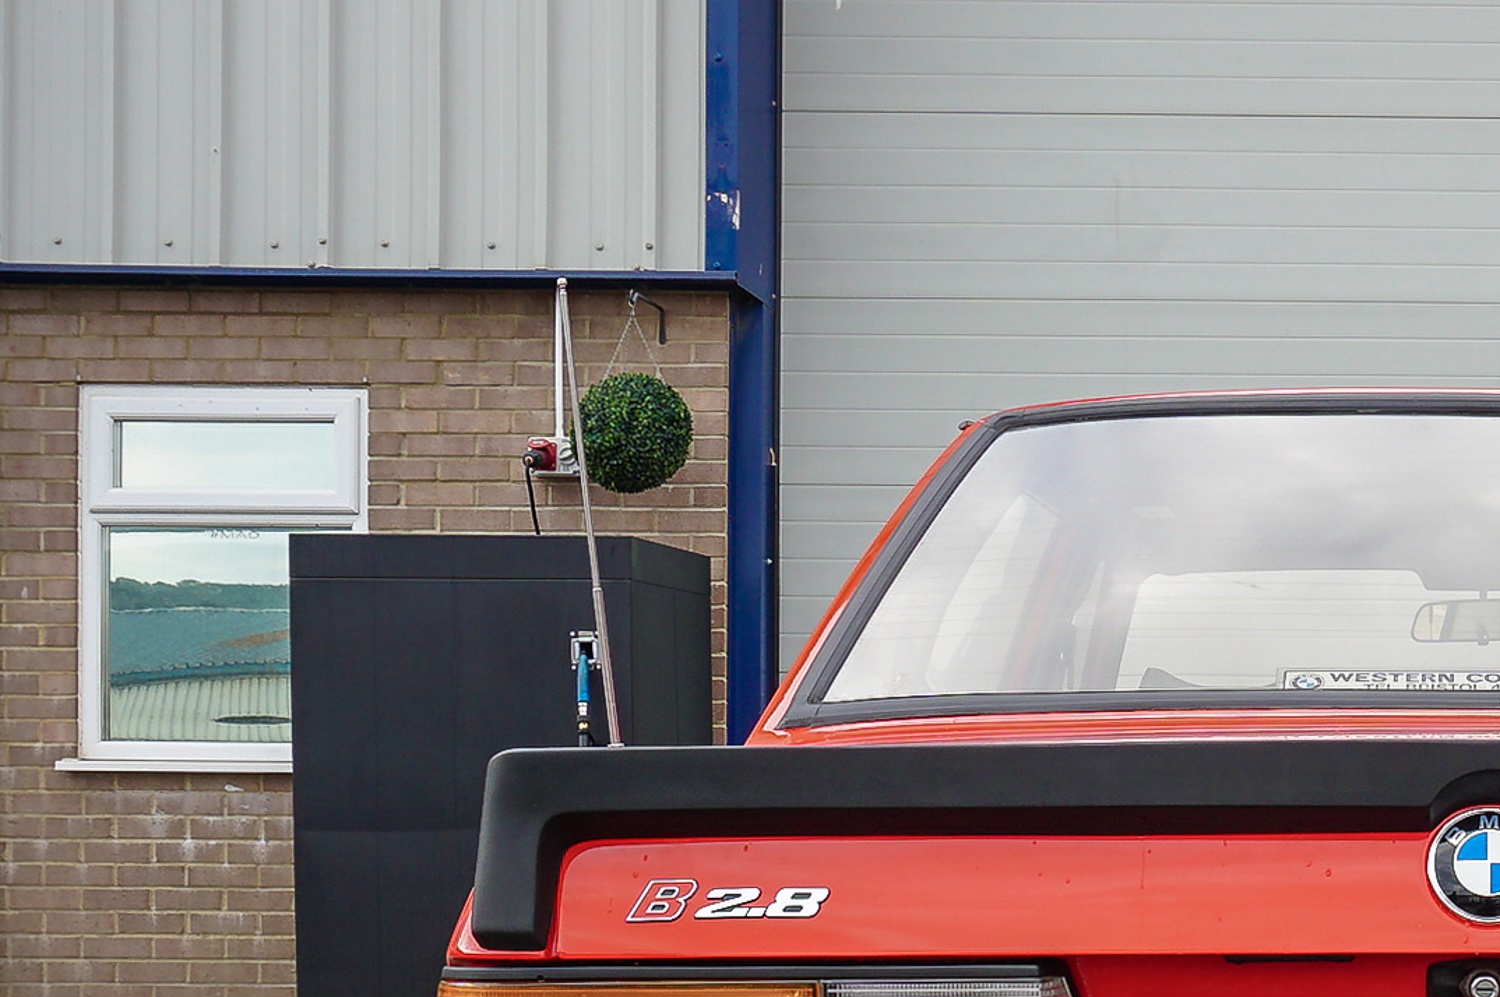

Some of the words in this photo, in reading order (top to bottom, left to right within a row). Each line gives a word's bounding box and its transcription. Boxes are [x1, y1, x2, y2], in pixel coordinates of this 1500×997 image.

[1330, 672, 1455, 683] WESTERN
[625, 878, 699, 923] B
[693, 887, 831, 920] 2.8
